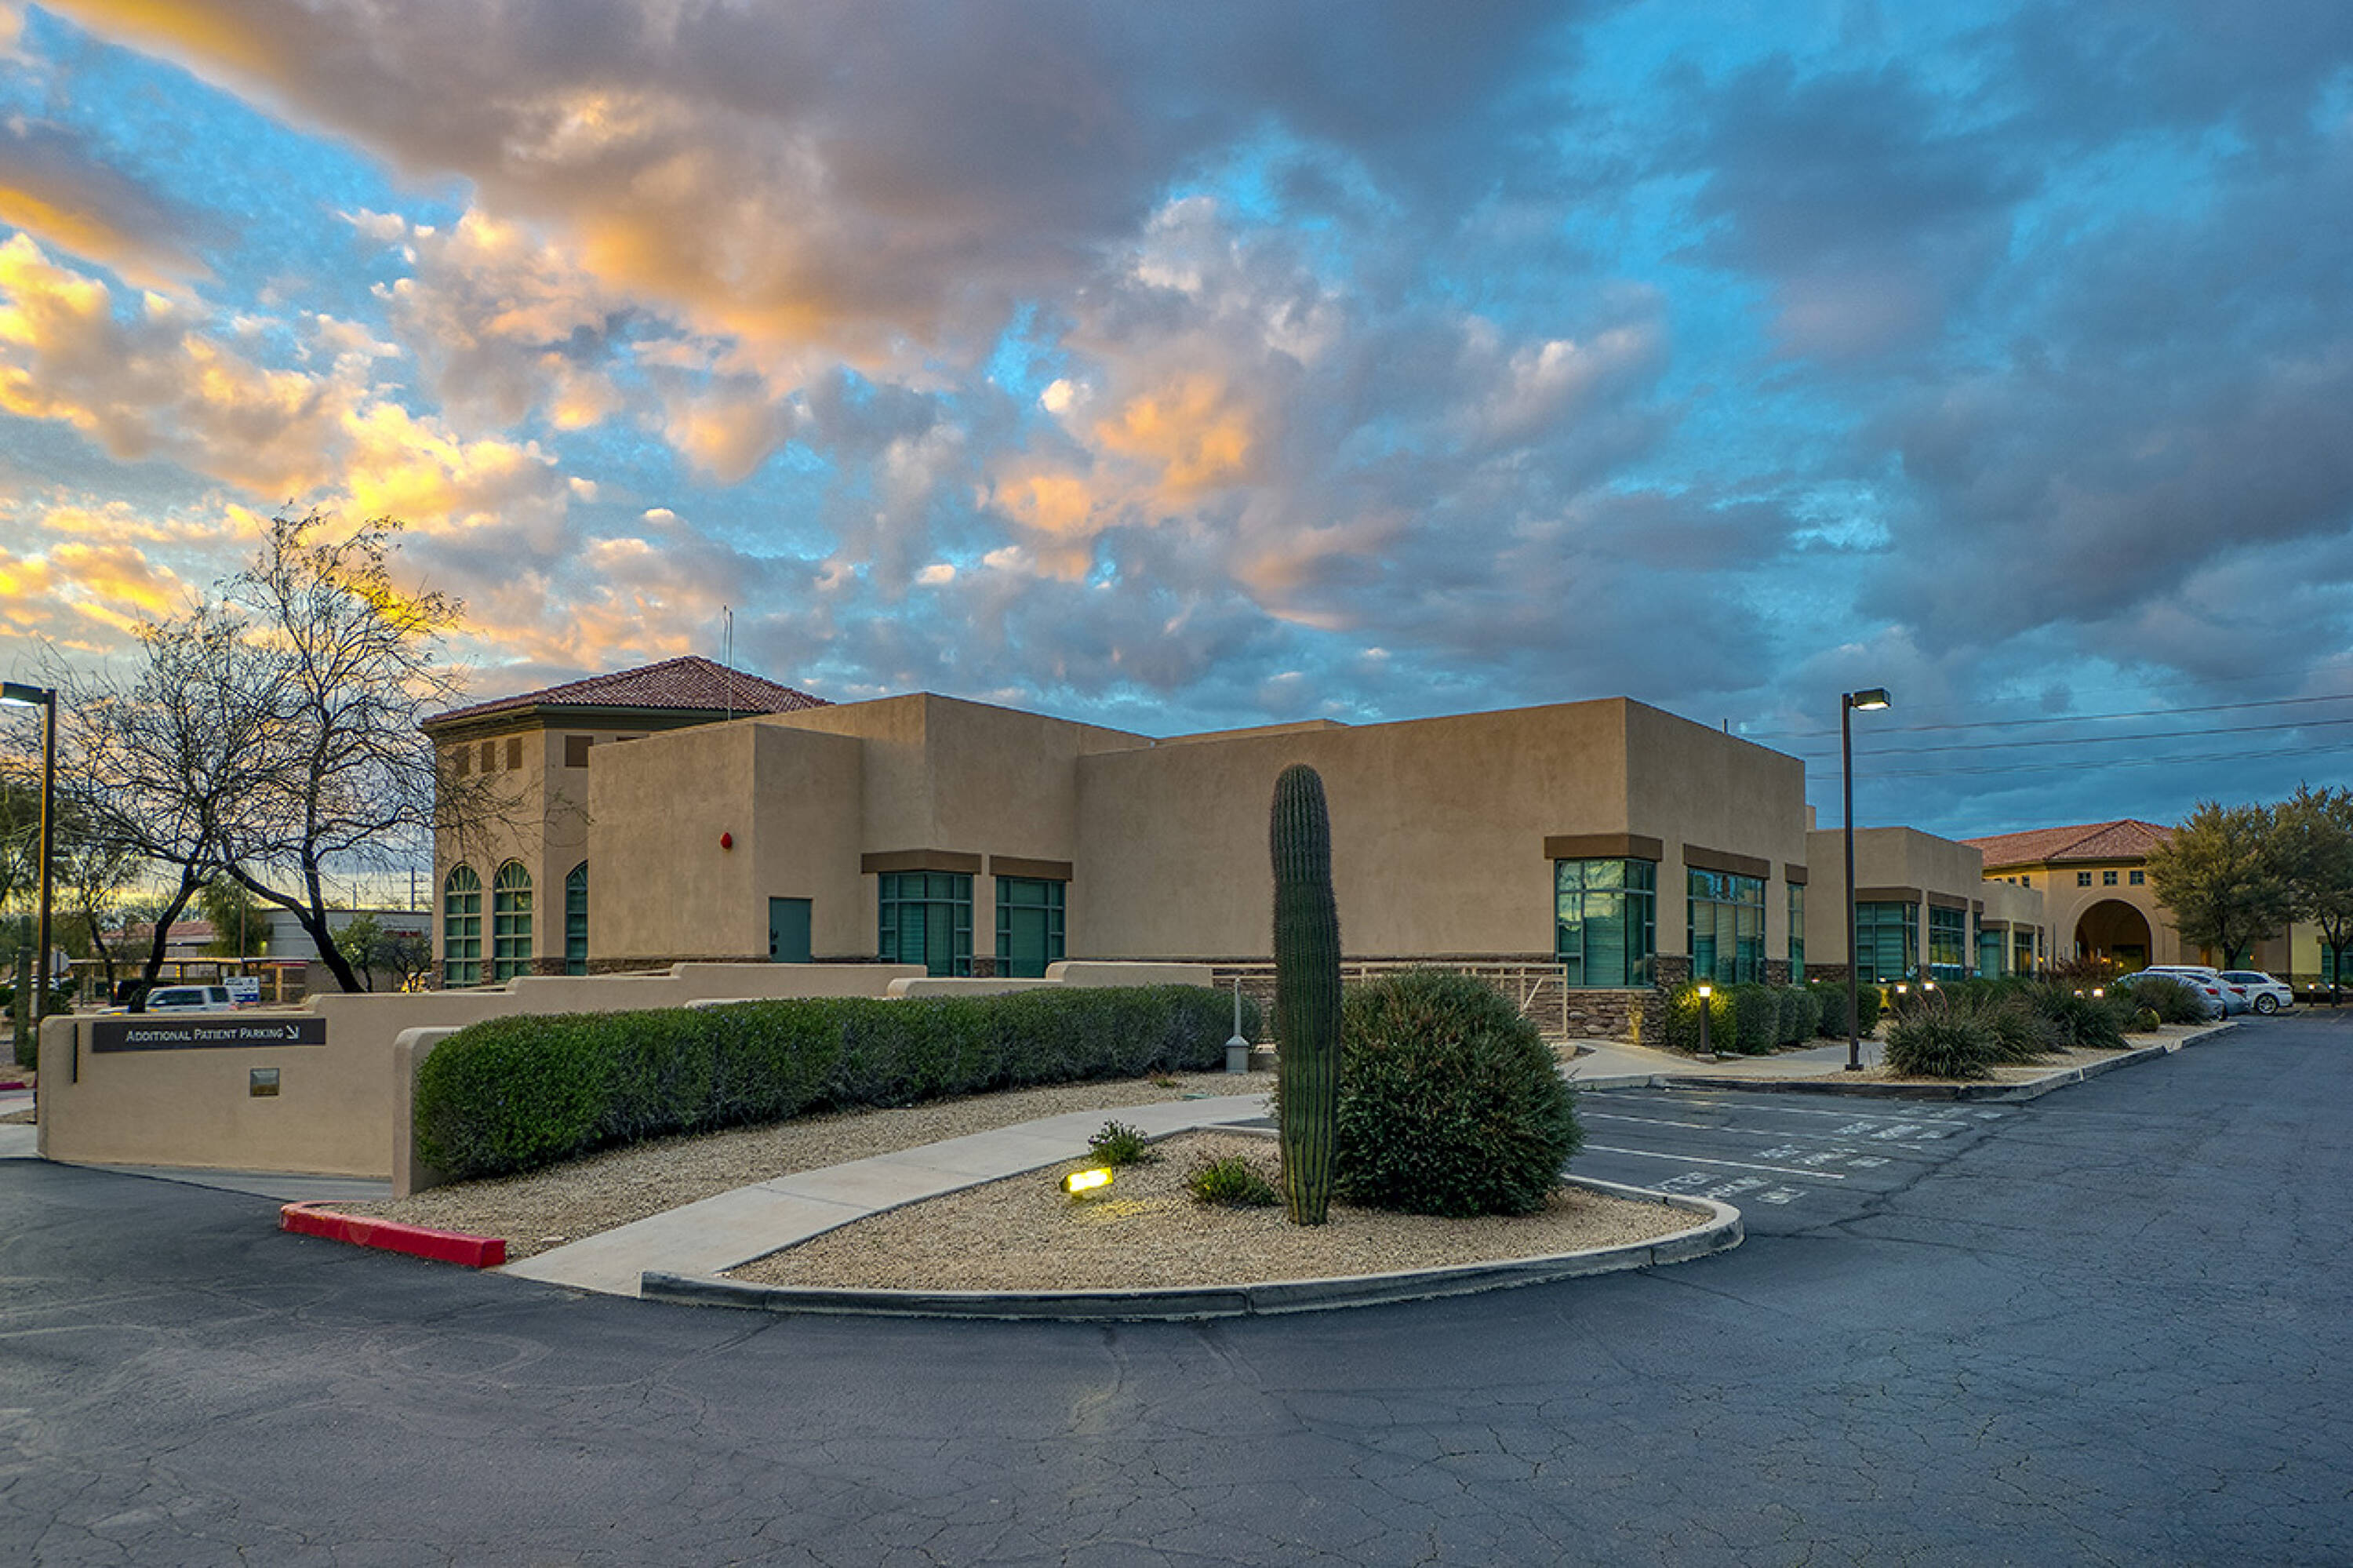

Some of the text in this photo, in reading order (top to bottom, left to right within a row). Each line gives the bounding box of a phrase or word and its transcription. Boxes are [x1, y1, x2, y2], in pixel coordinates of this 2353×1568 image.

[125, 1028, 283, 1042] ADDITIONAL PATIENT PARKING
